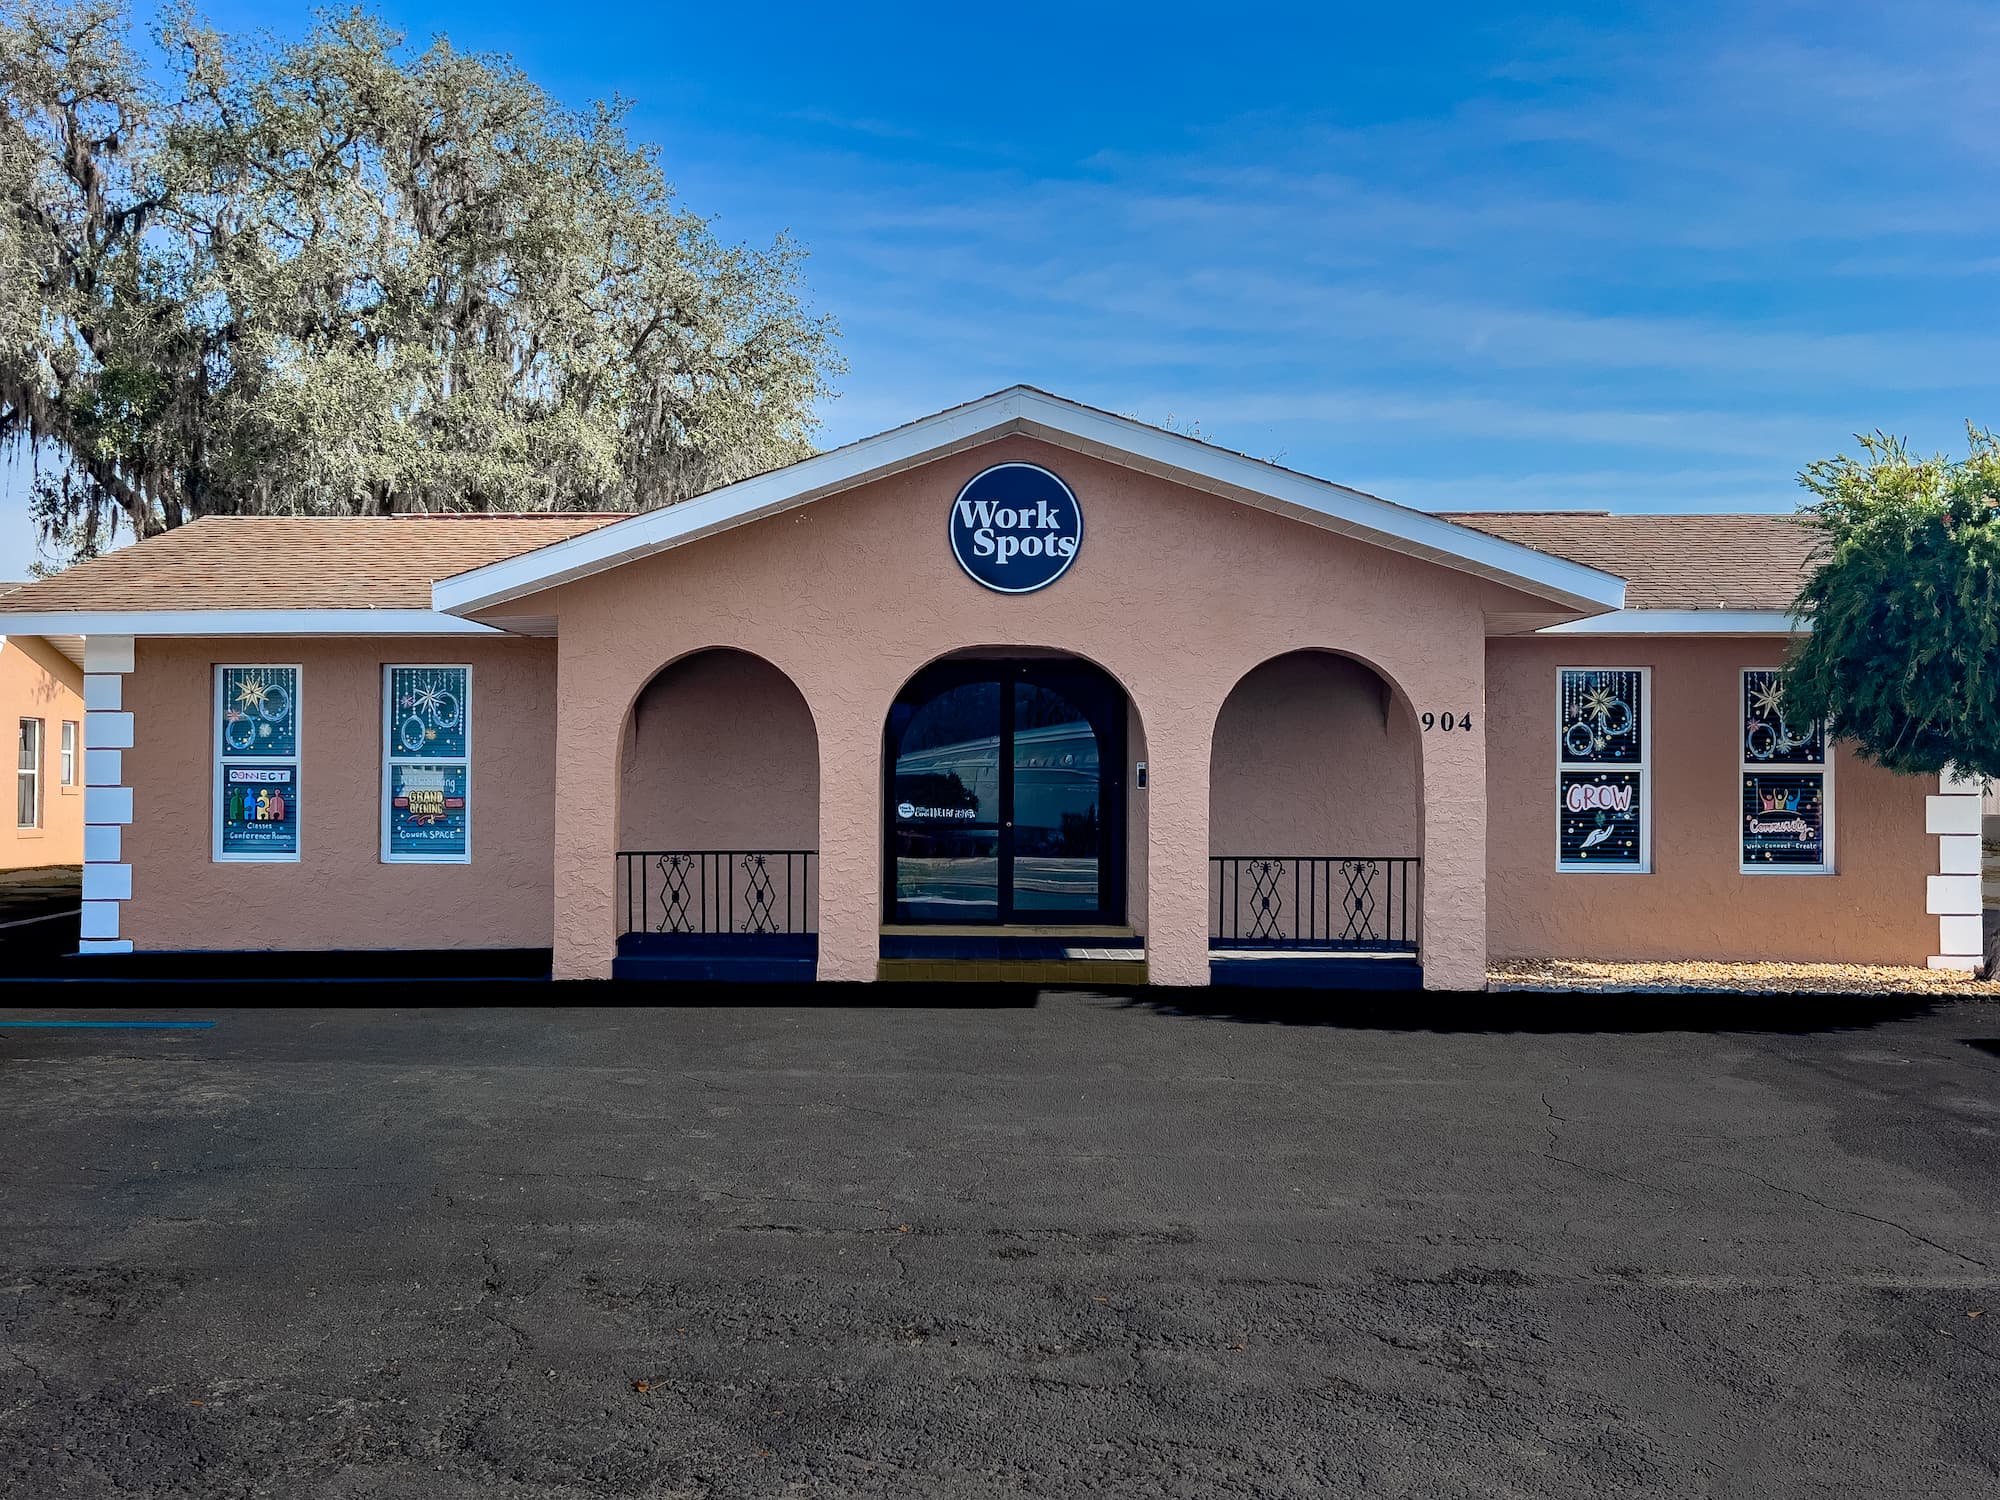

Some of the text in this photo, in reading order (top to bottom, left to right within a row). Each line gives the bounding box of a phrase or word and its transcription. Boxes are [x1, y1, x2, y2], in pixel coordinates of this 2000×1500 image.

[959, 500, 1061, 529] Work
[973, 528, 1077, 564] Spots
[1421, 711, 1473, 732] 904
[230, 771, 286, 781] CONNECT
[409, 790, 444, 803] GRAND
[1567, 784, 1632, 813] GROW
[409, 803, 443, 814] OPENING
[429, 830, 455, 839] SPACE
[1750, 818, 1814, 841] Community
